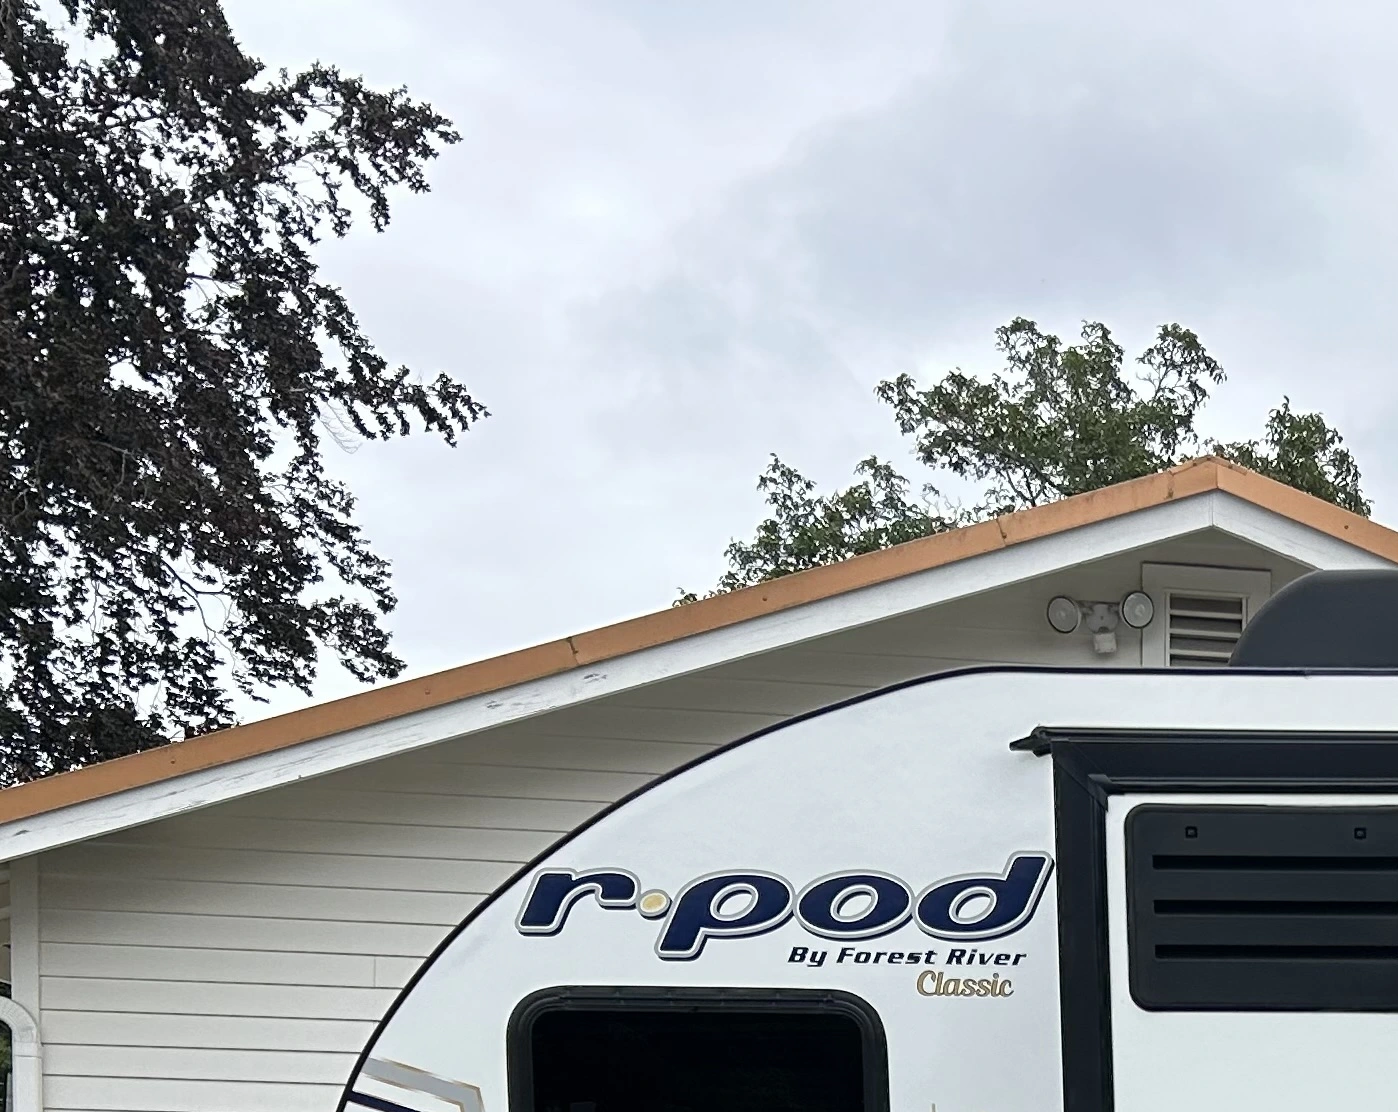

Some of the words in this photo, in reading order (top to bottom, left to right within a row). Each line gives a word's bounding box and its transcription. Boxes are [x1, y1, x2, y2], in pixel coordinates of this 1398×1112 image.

[787, 946, 827, 967] By
[836, 947, 938, 965] Forest
[946, 948, 1027, 966] River
[916, 970, 1014, 997] Classic
